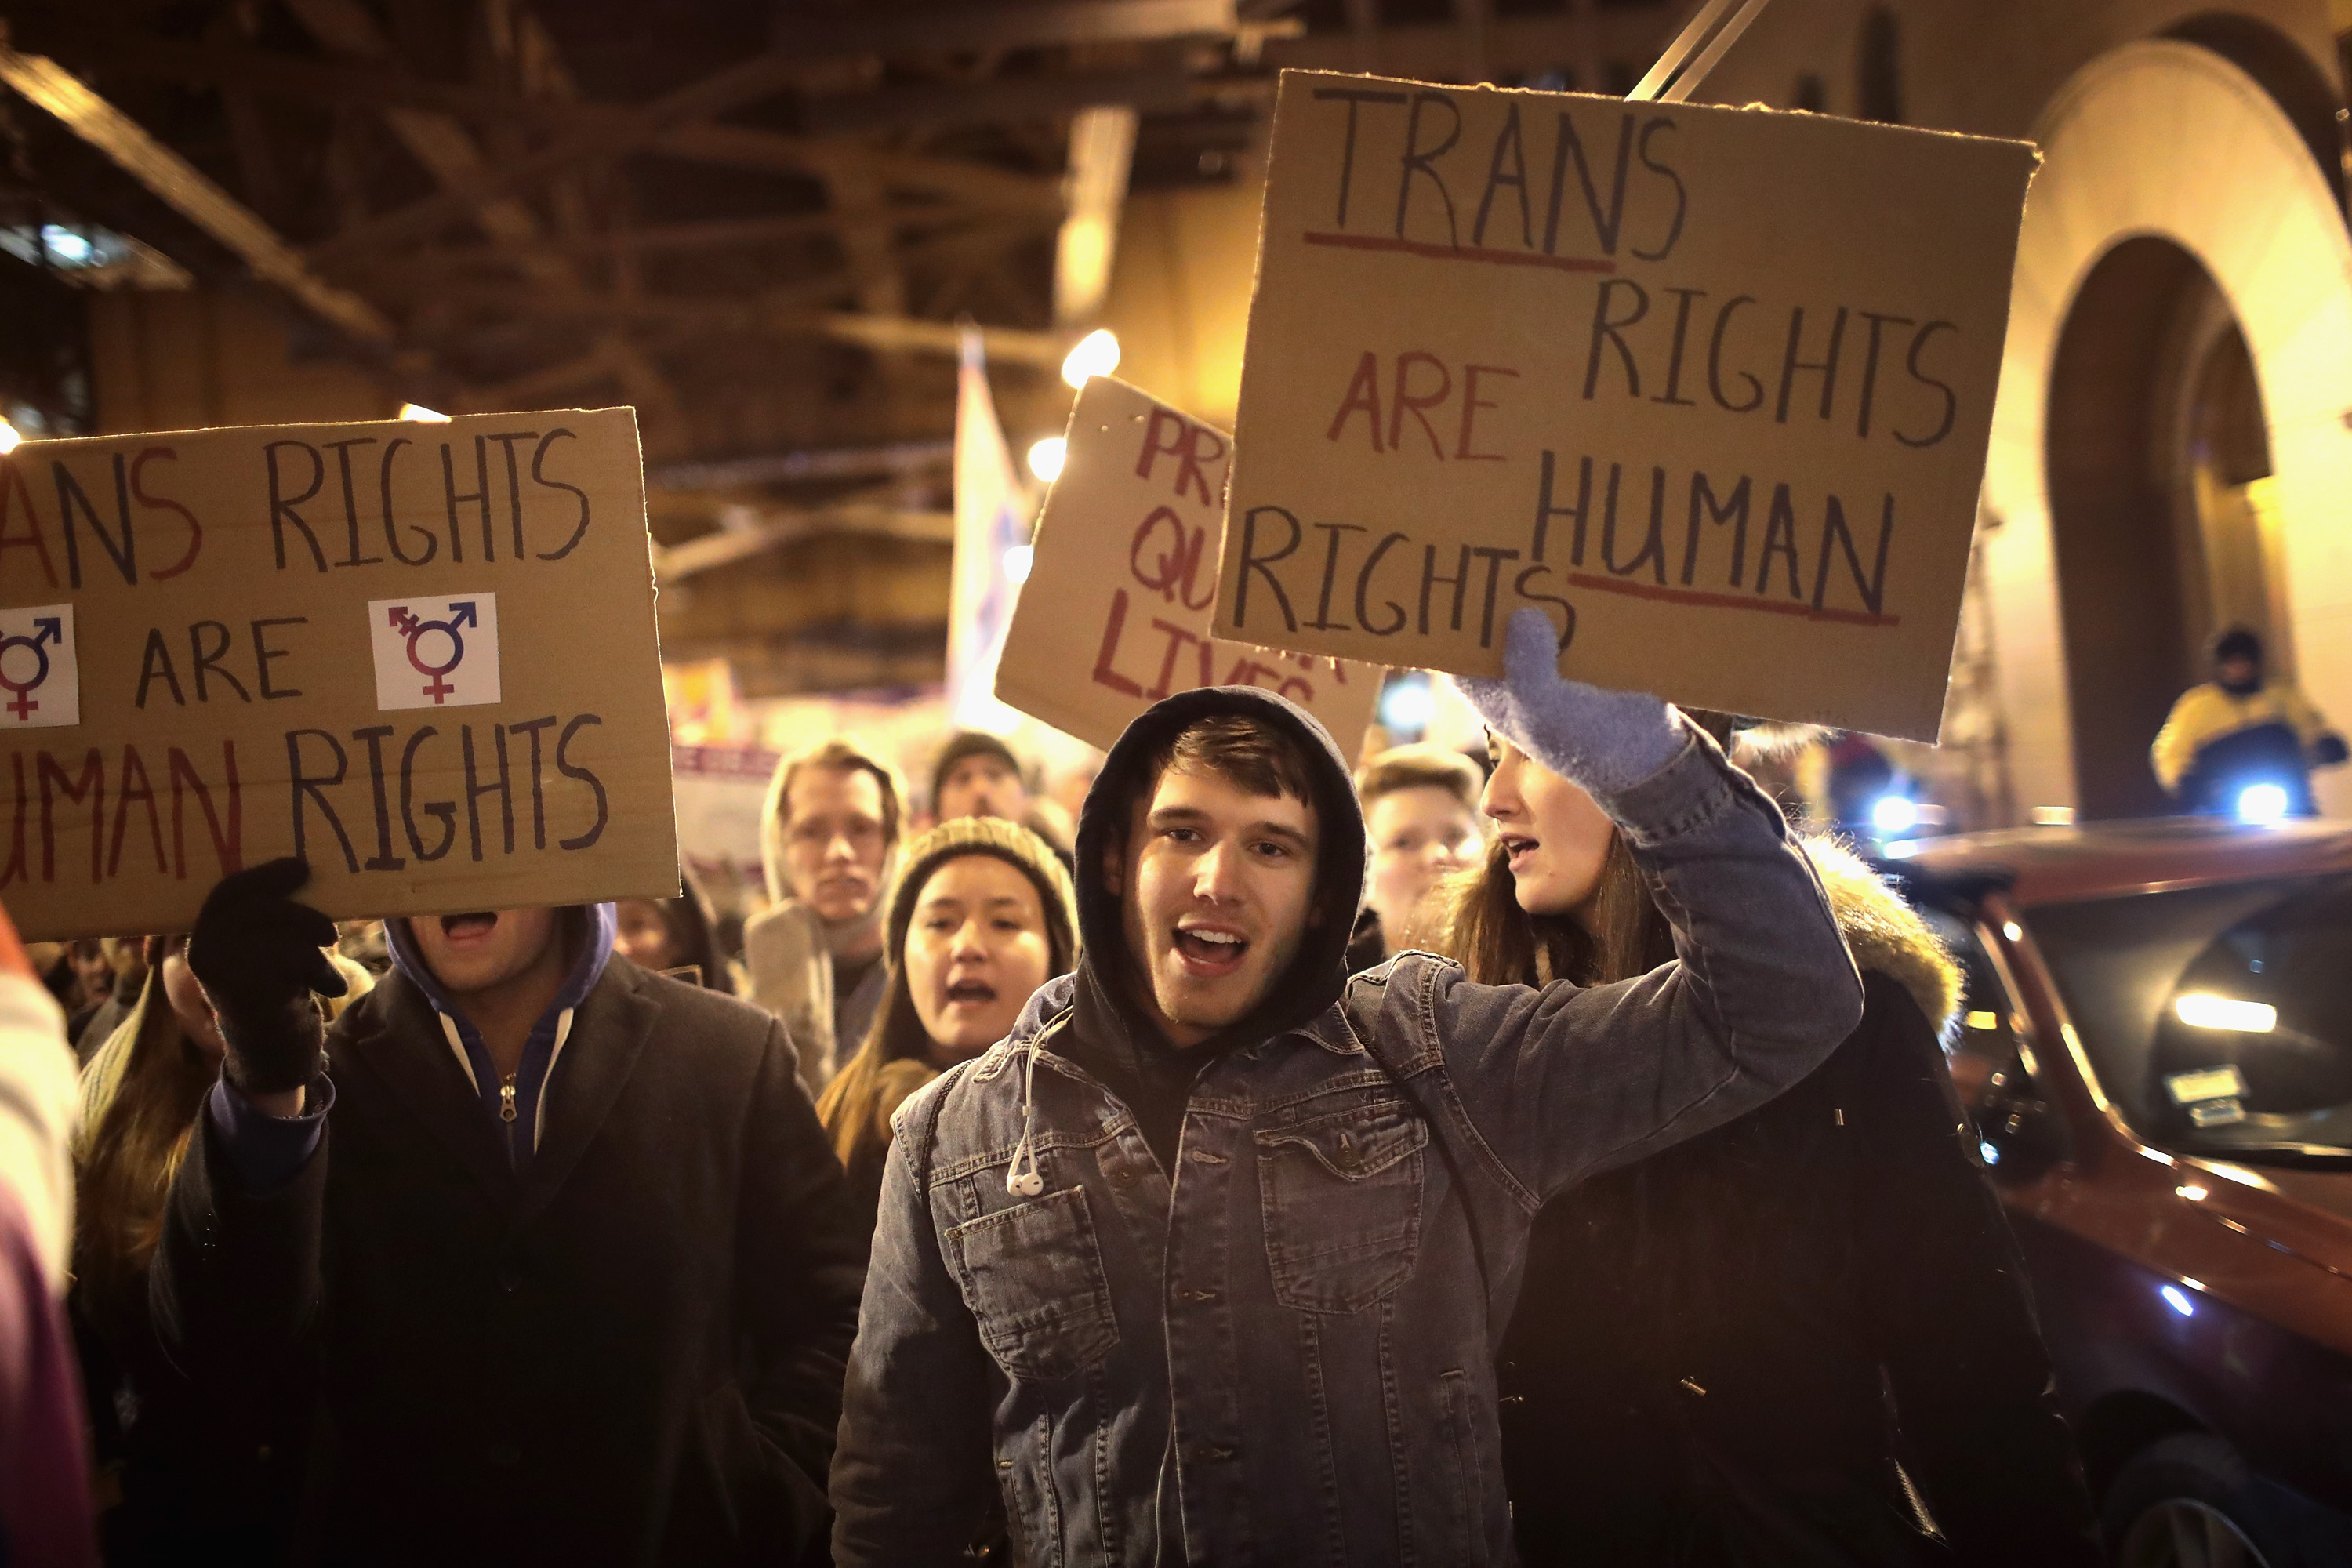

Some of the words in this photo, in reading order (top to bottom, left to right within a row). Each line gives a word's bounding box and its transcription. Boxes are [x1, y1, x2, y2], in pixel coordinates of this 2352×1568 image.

[1312, 88, 1686, 262] TRANS
[1327, 350, 1519, 462] ARE
[1582, 278, 1958, 448] RIGHTS
[0, 446, 202, 589] ANS
[263, 428, 590, 573] RIGHTS
[1232, 505, 1576, 657] RIGHTS
[1532, 449, 1894, 613] HUMAN
[135, 616, 308, 709] ARE
[285, 713, 608, 873] RIGHTS
